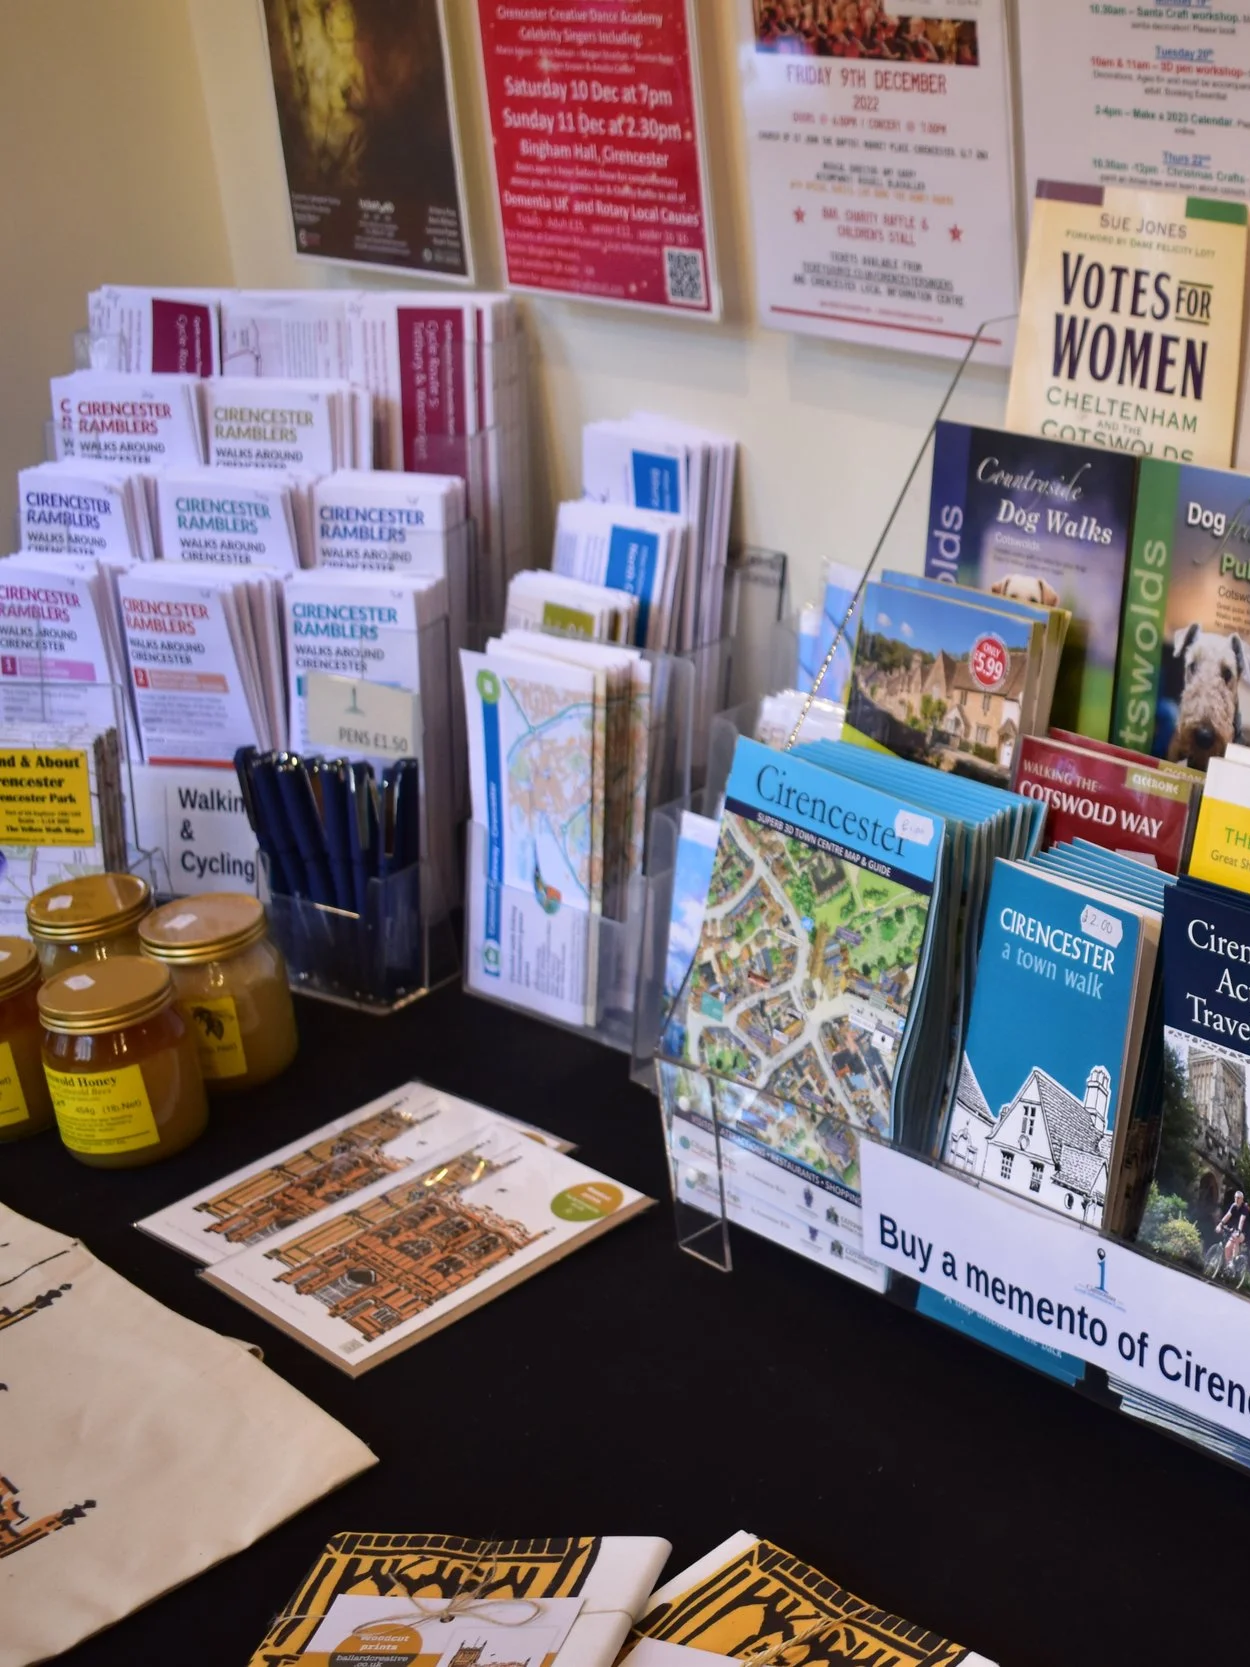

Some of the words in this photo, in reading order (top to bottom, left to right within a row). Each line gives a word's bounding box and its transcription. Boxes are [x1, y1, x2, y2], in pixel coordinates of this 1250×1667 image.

[1155, 46, 1196, 61] Tuesday
[504, 76, 567, 102] Saturday
[572, 79, 588, 100] 10
[591, 80, 617, 104] Dec
[622, 84, 637, 104] at
[640, 84, 672, 108] 7pm
[787, 64, 832, 86] FRIDAY
[841, 69, 866, 88] 9TH
[874, 71, 947, 94] DECEMBER
[1061, 251, 1172, 321] VOTES
[1175, 287, 1211, 319] FOR
[1052, 312, 1208, 401] WOMEN
[77, 401, 172, 419] CIRENCESTER
[1046, 386, 1197, 433] CHELTENHAM
[79, 417, 158, 435] RAMBLERS
[26, 492, 112, 515] CIRENCESTER
[27, 509, 100, 530] RAMBLERS
[996, 499, 1040, 534] Dog
[1047, 509, 1113, 545] Walks
[1188, 502, 1226, 537] Dog
[293, 604, 397, 623] CIRENCESTER
[294, 623, 378, 640] RAMBLERS
[983, 642, 1000, 658] ONLY
[974, 651, 1003, 679] £5.99
[339, 727, 370, 745] PENS
[374, 733, 408, 752] £1.50
[36, 755, 79, 768] About
[1019, 780, 1117, 826] COTSWOLD
[1121, 809, 1163, 838] WAY
[757, 812, 784, 830] SUPERB
[785, 823, 795, 834] 3D
[795, 827, 817, 844] TOWN
[817, 837, 844, 856] CENTRE
[844, 849, 860, 863] MAP
[861, 856, 867, 866] &
[868, 860, 892, 877] GUIDE
[1211, 850, 1238, 866] Great
[181, 851, 255, 883] Cycling
[1000, 907, 1115, 975] CIRENCESTER
[1002, 943, 1011, 960] a
[1016, 947, 1057, 980] town
[1065, 968, 1104, 999] walk
[78, 1076, 117, 1087] Honey
[879, 1212, 933, 1274] Buy
[942, 1250, 957, 1282] a
[967, 1264, 1108, 1347] memento
[1119, 1331, 1148, 1368] of
[360, 1643, 398, 1651] prints
